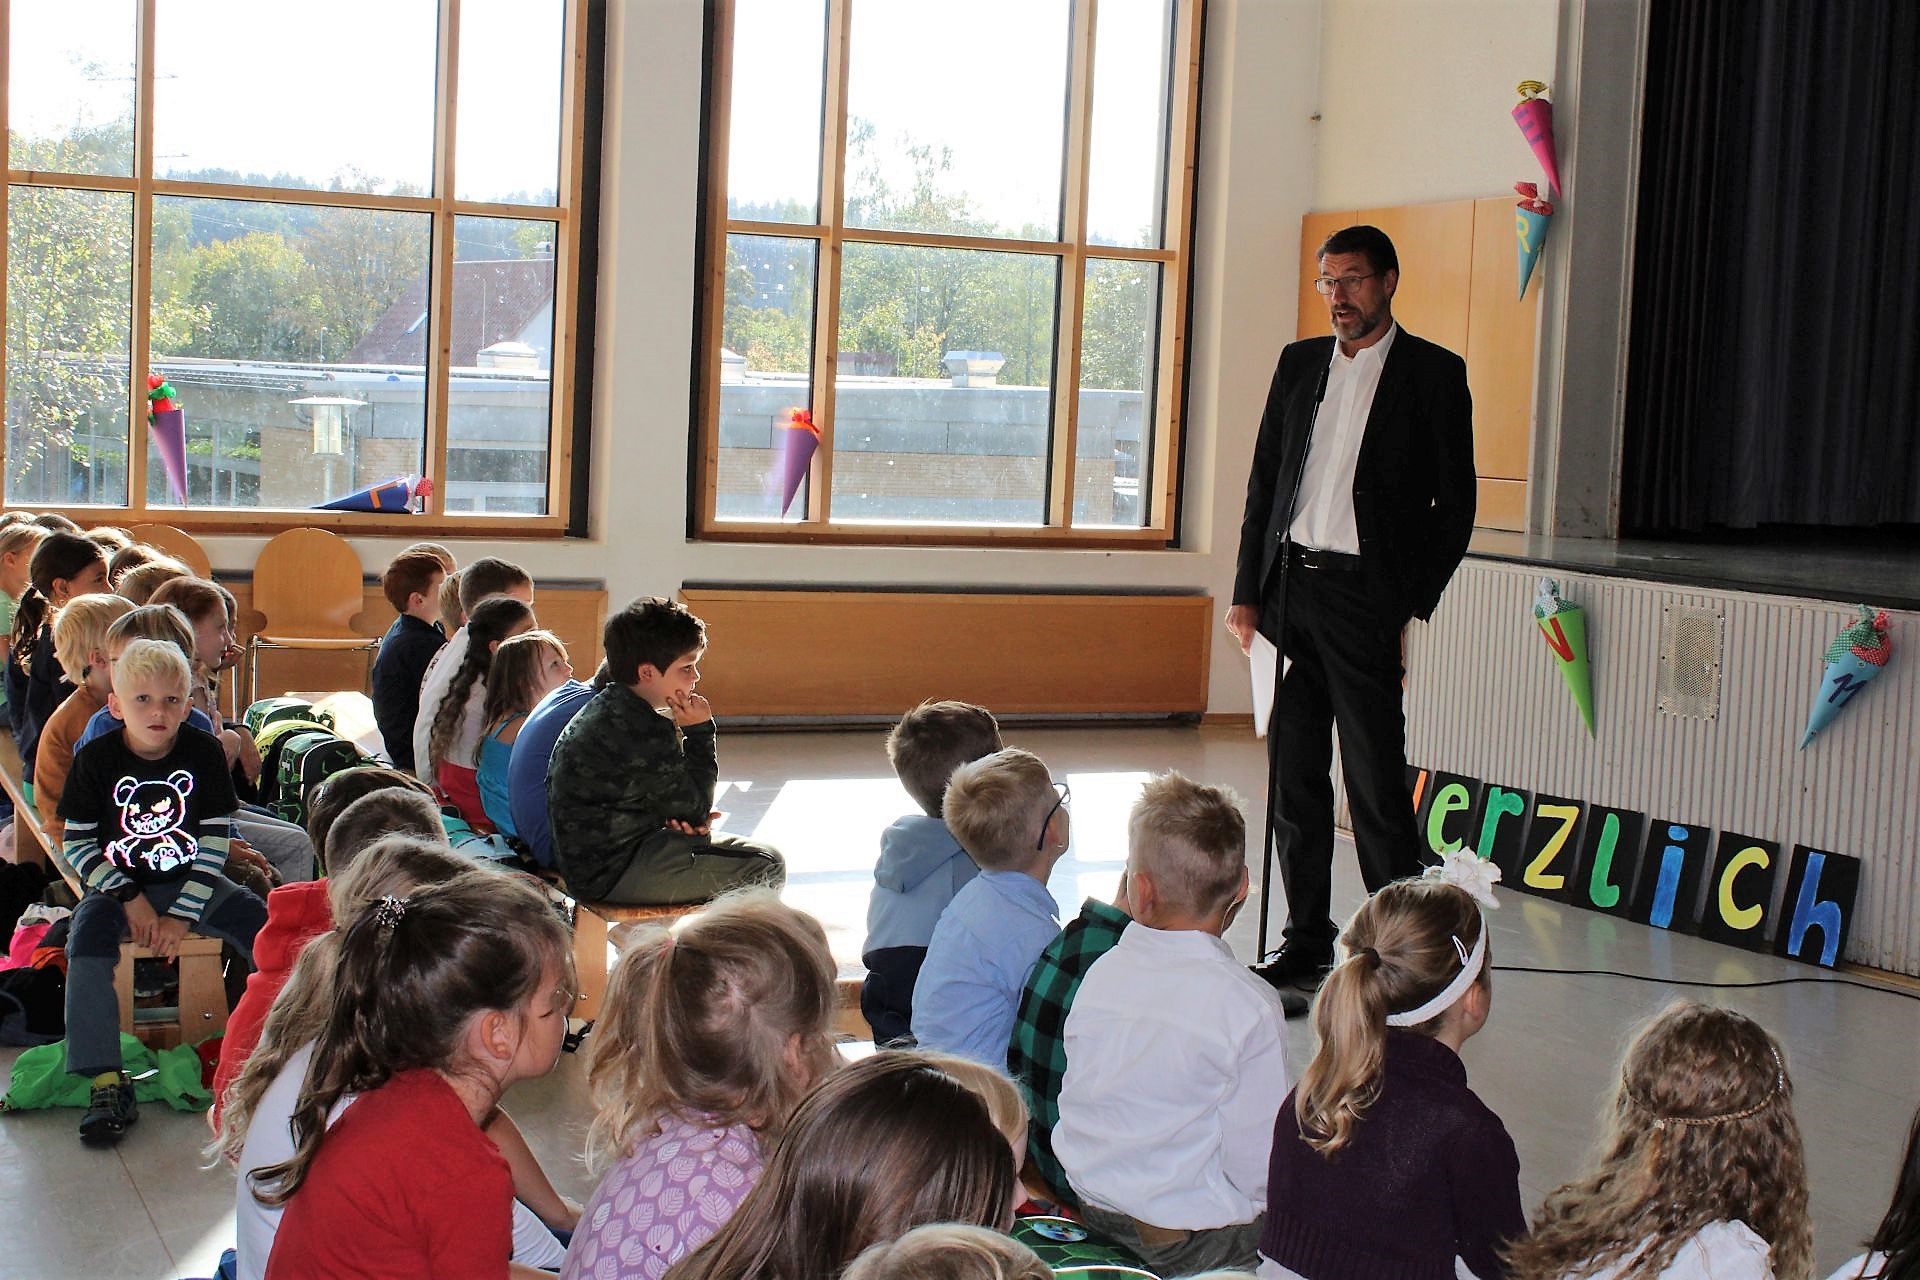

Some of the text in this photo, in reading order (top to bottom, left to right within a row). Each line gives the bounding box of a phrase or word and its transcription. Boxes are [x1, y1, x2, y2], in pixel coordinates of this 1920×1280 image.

[1516, 214, 1530, 254] R
[1538, 617, 1576, 663] V
[1828, 673, 1868, 708] M
[1412, 770, 1842, 967] erzlich
